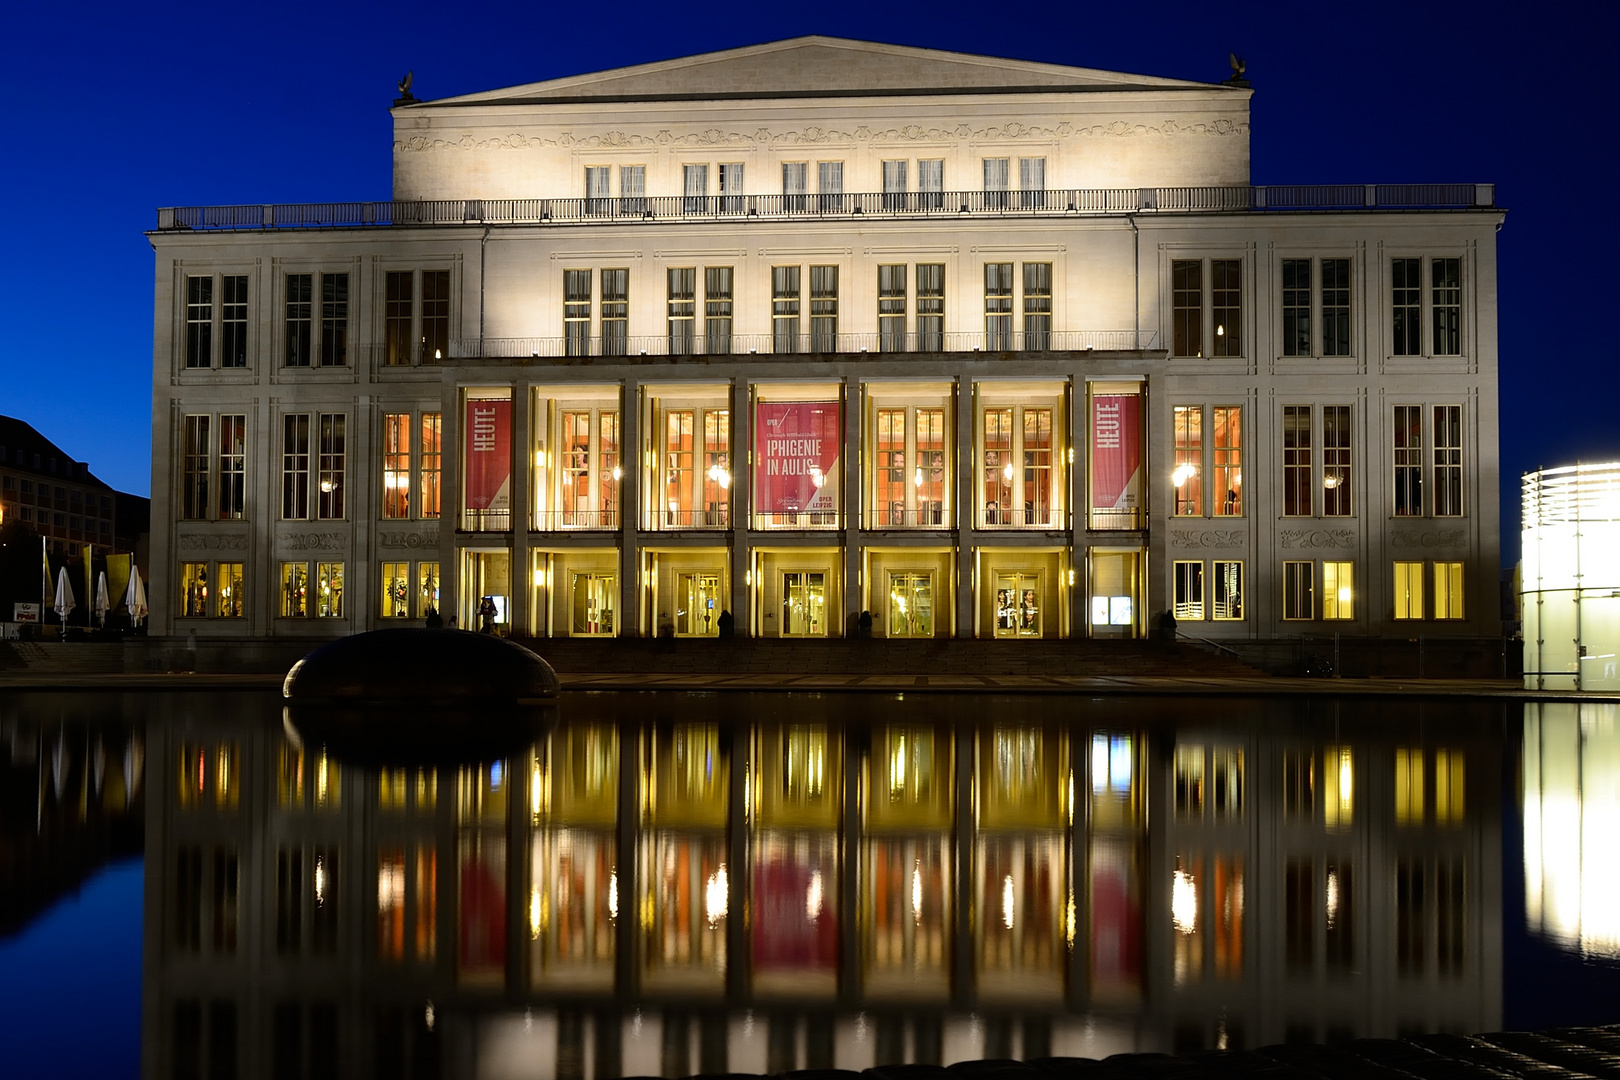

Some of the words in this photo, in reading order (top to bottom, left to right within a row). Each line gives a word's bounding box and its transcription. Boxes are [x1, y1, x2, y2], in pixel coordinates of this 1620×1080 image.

[474, 407, 496, 451] HEUTE
[1097, 403, 1119, 448] HEUTE
[767, 439, 822, 457] IPHIGENIE
[767, 459, 779, 476] IN
